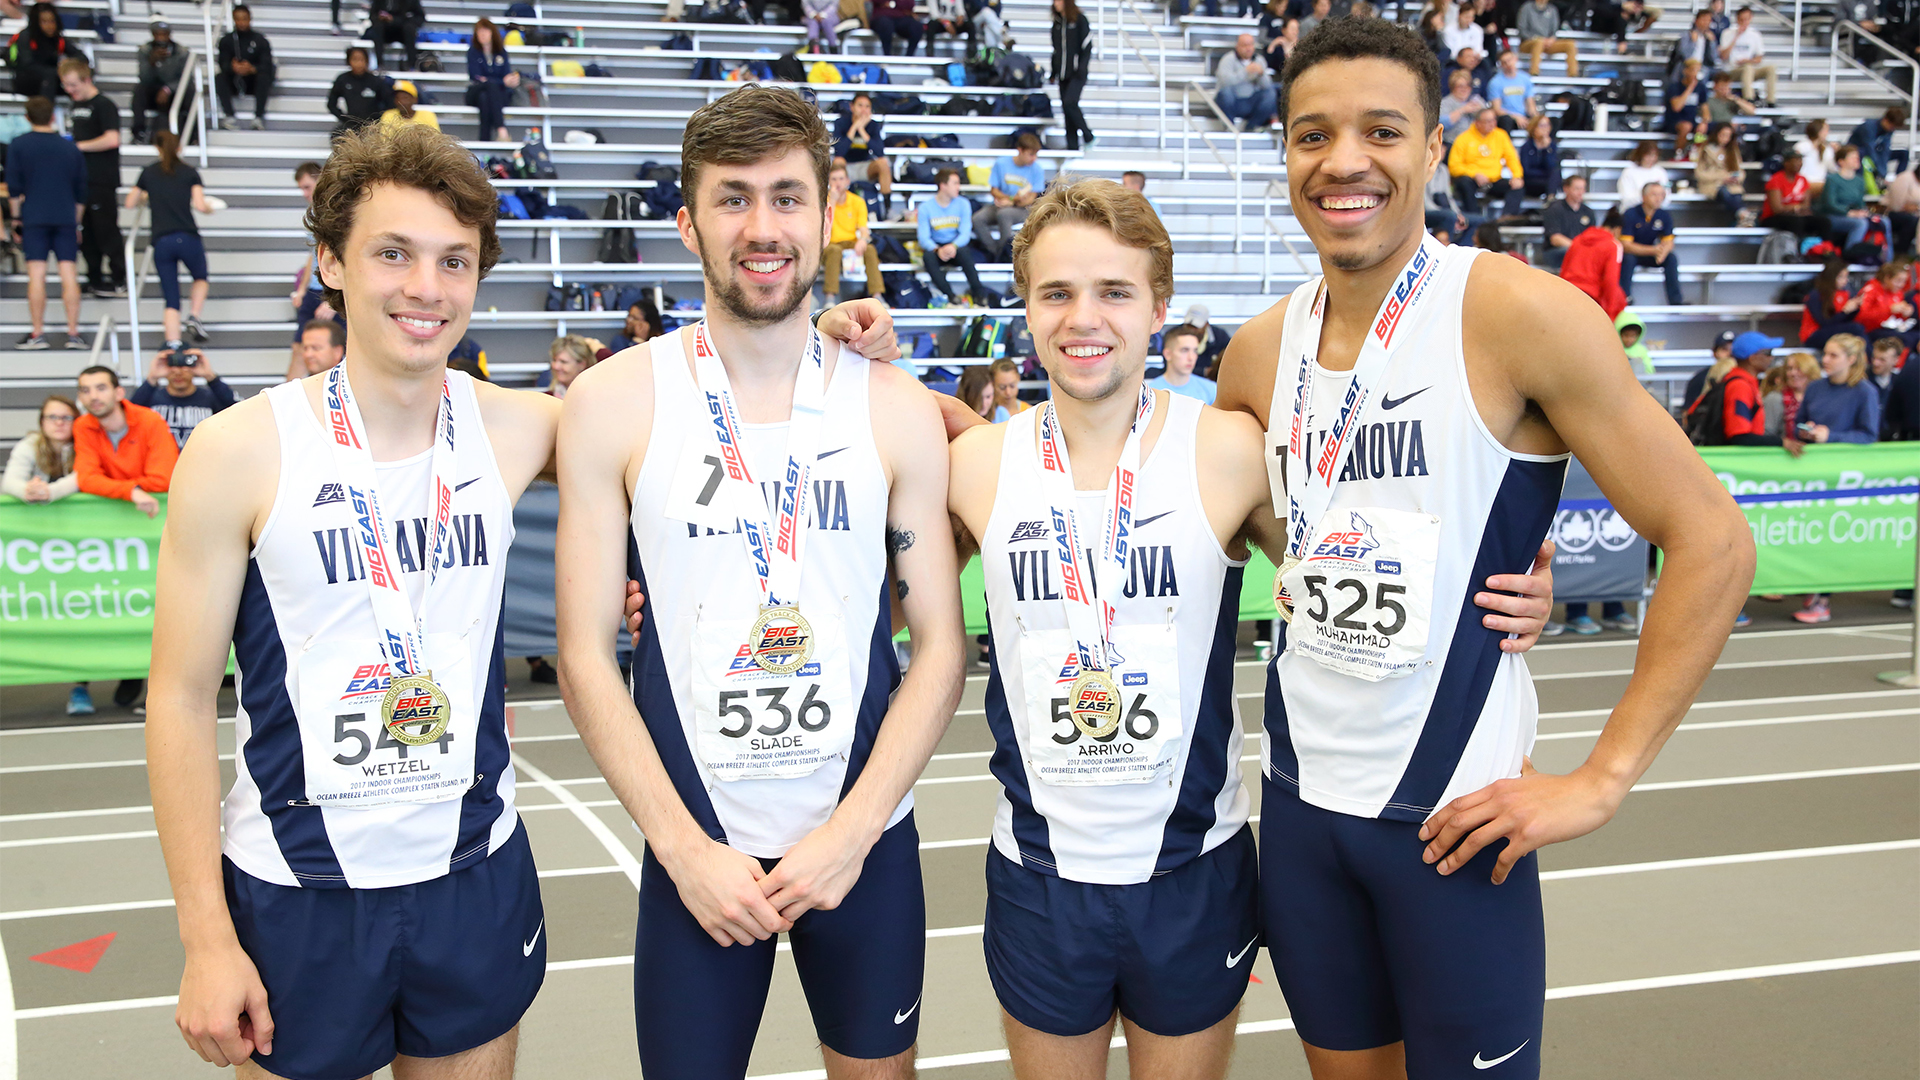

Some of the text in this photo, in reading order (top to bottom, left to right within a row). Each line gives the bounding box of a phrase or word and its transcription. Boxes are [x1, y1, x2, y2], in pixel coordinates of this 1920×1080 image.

[1394, 243, 1431, 304] EAST
[1411, 258, 1440, 307] CONFERENCE
[706, 391, 732, 445] EAST
[723, 390, 742, 440] CONFERENCE
[1332, 374, 1362, 441] EAST
[1345, 388, 1370, 443] CONFERENCE
[1043, 441, 1056, 471] BIG
[315, 492, 346, 502] EAS
[782, 455, 800, 517] EAST
[800, 465, 811, 516] CONFERENCE
[348, 485, 378, 549] EAST
[370, 488, 389, 544] CONFERENCE
[1016, 520, 1045, 531] BIG
[1011, 529, 1050, 539] EAST
[1050, 505, 1073, 565] EAST
[1069, 508, 1083, 560] CONFERENCE
[1104, 508, 1113, 561] CONFERENCE
[1114, 506, 1131, 569] EAST
[1291, 511, 1308, 557] AST
[1322, 531, 1364, 545] BIG
[1750, 512, 1824, 546] hletic
[0, 536, 150, 574] cean
[312, 514, 489, 585] VIANVA
[1313, 543, 1373, 559] EAST
[1008, 546, 1179, 601] VILOVA
[1378, 563, 1399, 573] Jeep
[0, 579, 152, 621] thletic
[1303, 575, 1407, 636] 525
[759, 635, 809, 649] EAST
[764, 626, 800, 638] BIG
[1316, 625, 1391, 649] MUHAMMAD
[385, 628, 411, 675] AST
[1317, 638, 1329, 647] 2017
[1347, 646, 1386, 660] CHAMPIONSHIPS
[798, 665, 819, 674] Jeep
[1125, 675, 1146, 685] Jeep
[345, 677, 392, 693] EAS
[1080, 690, 1108, 701] BIG
[392, 705, 444, 720] EAST
[396, 695, 432, 710] BIG
[719, 683, 831, 739] 536
[1076, 700, 1115, 712] EAST
[750, 735, 804, 750] SLADE
[750, 751, 773, 760] INDOOR
[774, 747, 820, 759] CHAMPIONSHIPS
[1078, 742, 1134, 756] ARRIVO
[361, 759, 431, 777] WETZEL
[745, 761, 770, 769] ATHLETIC
[771, 759, 797, 767] COMPLEX
[799, 757, 818, 765] STATEN
[1077, 766, 1101, 774] ATHLETIC
[1102, 765, 1126, 773] COMPLEX
[1127, 763, 1146, 771] STATEN
[1104, 755, 1149, 764] CHAMPIONSHIPS
[316, 793, 338, 801] OCEAN
[338, 791, 361, 800] BREEZE
[362, 788, 390, 798] ATHLETIC
[390, 785, 419, 795] COMPLEX
[420, 782, 440, 791] STATEN
[350, 772, 442, 790] 2017 INDOOR CHAMPIONSHIPS
